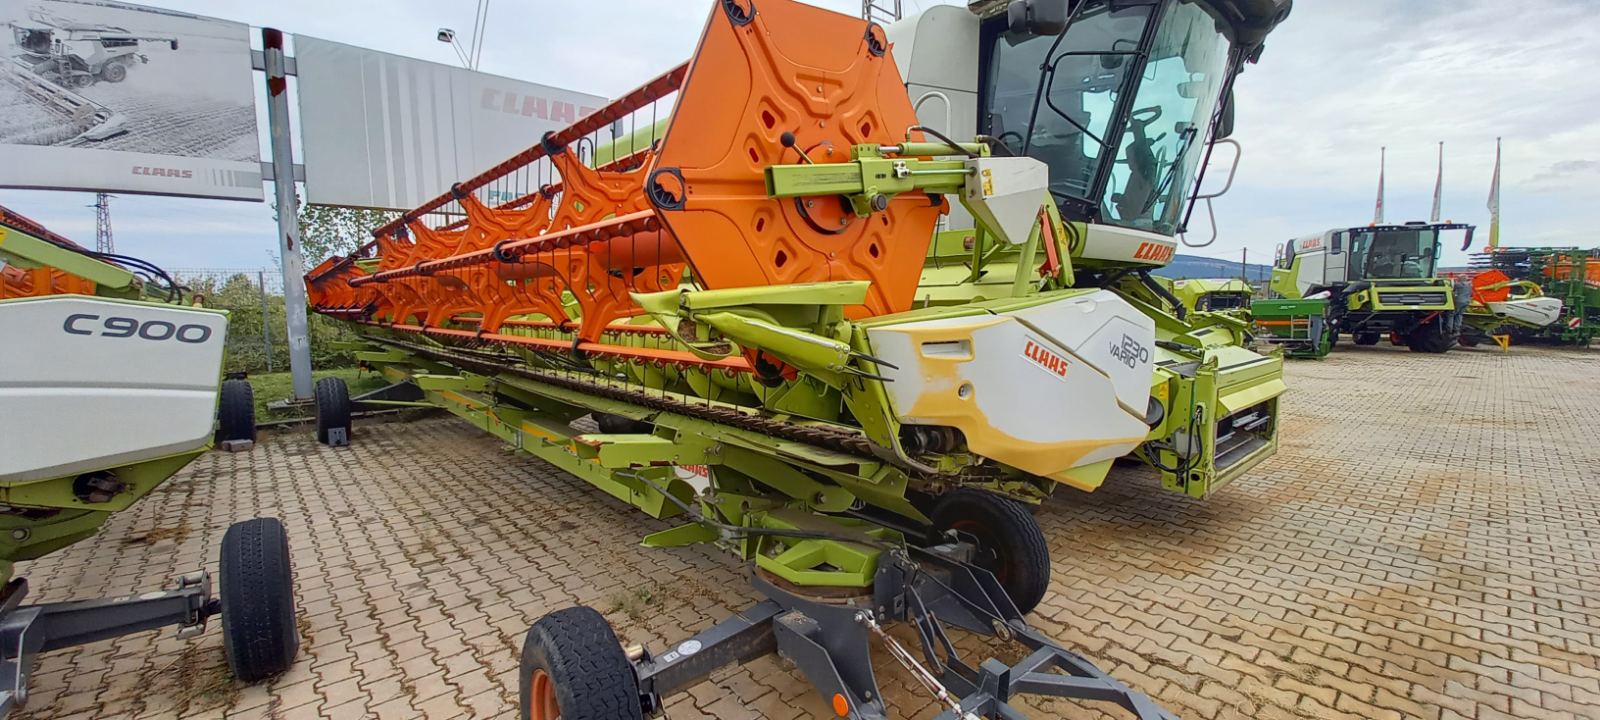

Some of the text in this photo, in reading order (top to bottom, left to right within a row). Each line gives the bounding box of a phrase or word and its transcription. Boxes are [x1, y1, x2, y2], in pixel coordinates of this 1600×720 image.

[132, 166, 192, 179] CLAAS
[1134, 242, 1174, 262] CLAAS
[101, 316, 212, 344] 900
[1024, 340, 1069, 377] CLAAS
[1109, 341, 1137, 369] VARIO
[1121, 333, 1149, 364] 1230
